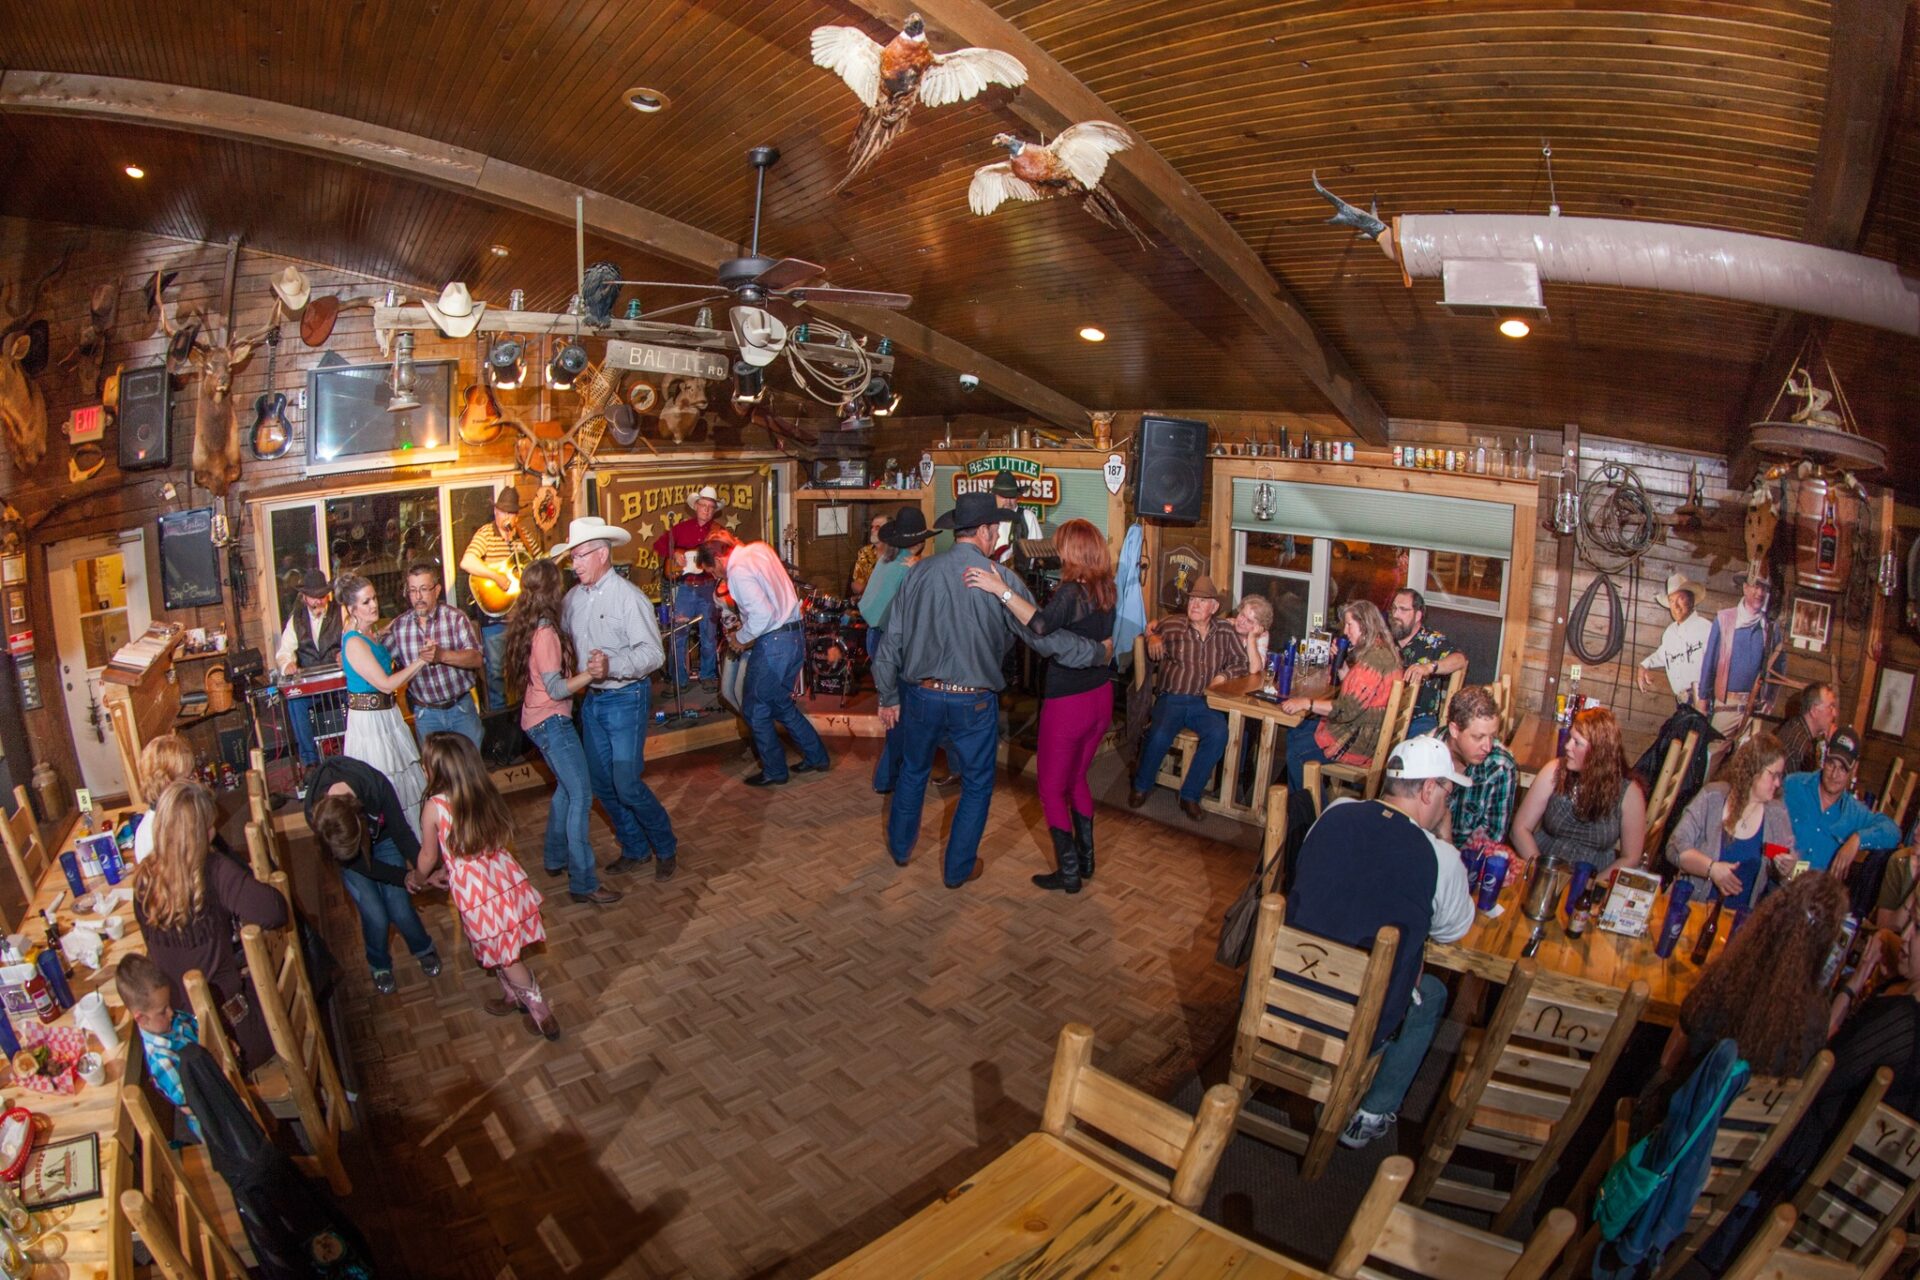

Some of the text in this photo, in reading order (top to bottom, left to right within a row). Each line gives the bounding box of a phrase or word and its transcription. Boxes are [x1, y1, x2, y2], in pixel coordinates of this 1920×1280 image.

[75, 407, 101, 433] EXIT
[968, 456, 1038, 476] BEST LITTLE
[1108, 465, 1122, 476] 187
[825, 716, 850, 727] Y-4
[504, 766, 530, 783] Y-4
